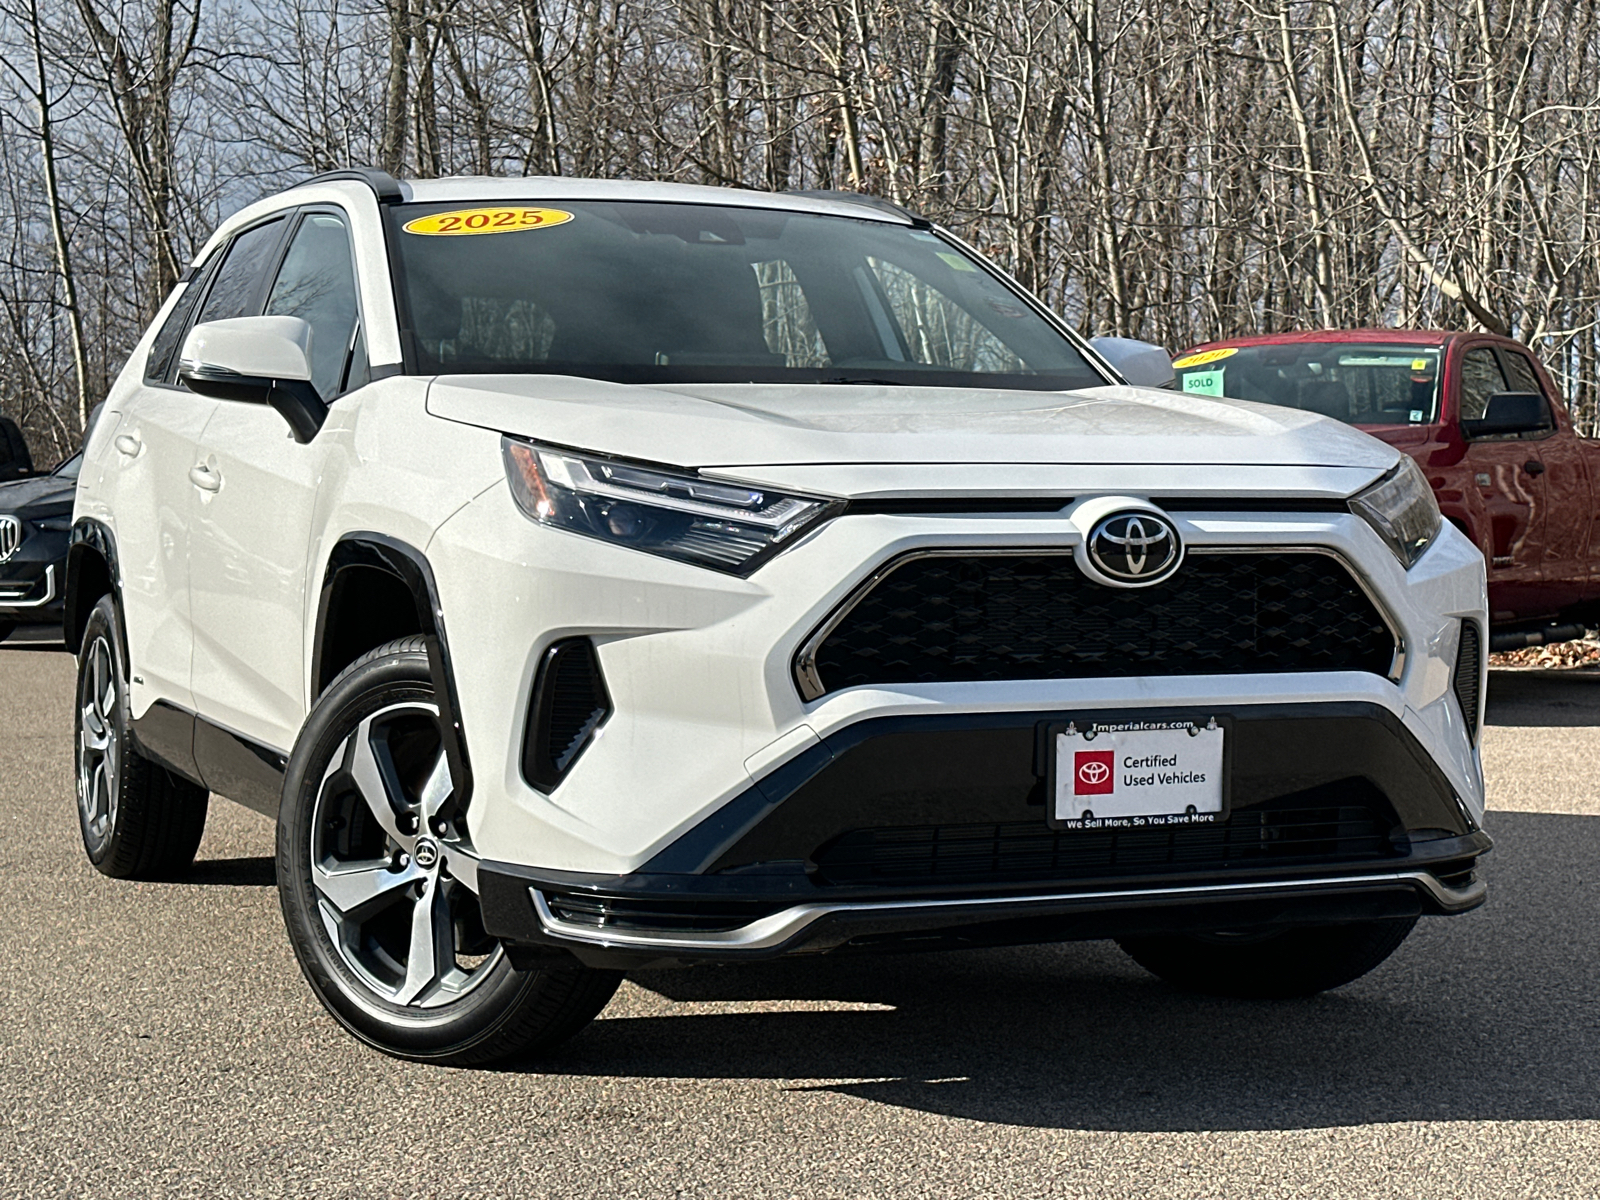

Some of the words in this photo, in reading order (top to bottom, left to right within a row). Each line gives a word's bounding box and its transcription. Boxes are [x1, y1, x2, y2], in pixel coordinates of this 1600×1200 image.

[438, 210, 544, 232] 2025
[1188, 378, 1213, 389] SOLD
[1092, 721, 1194, 733] Imperialcars.com
[1123, 754, 1177, 769] Certified
[1123, 773, 1155, 787] Used
[1157, 771, 1206, 786] Vehicles
[1067, 820, 1083, 829] We
[1085, 819, 1102, 828] Sell
[1104, 818, 1131, 828] More,
[1133, 817, 1145, 826] So
[1147, 816, 1165, 825] You
[1168, 815, 1189, 824] Save
[1192, 814, 1215, 823] More
